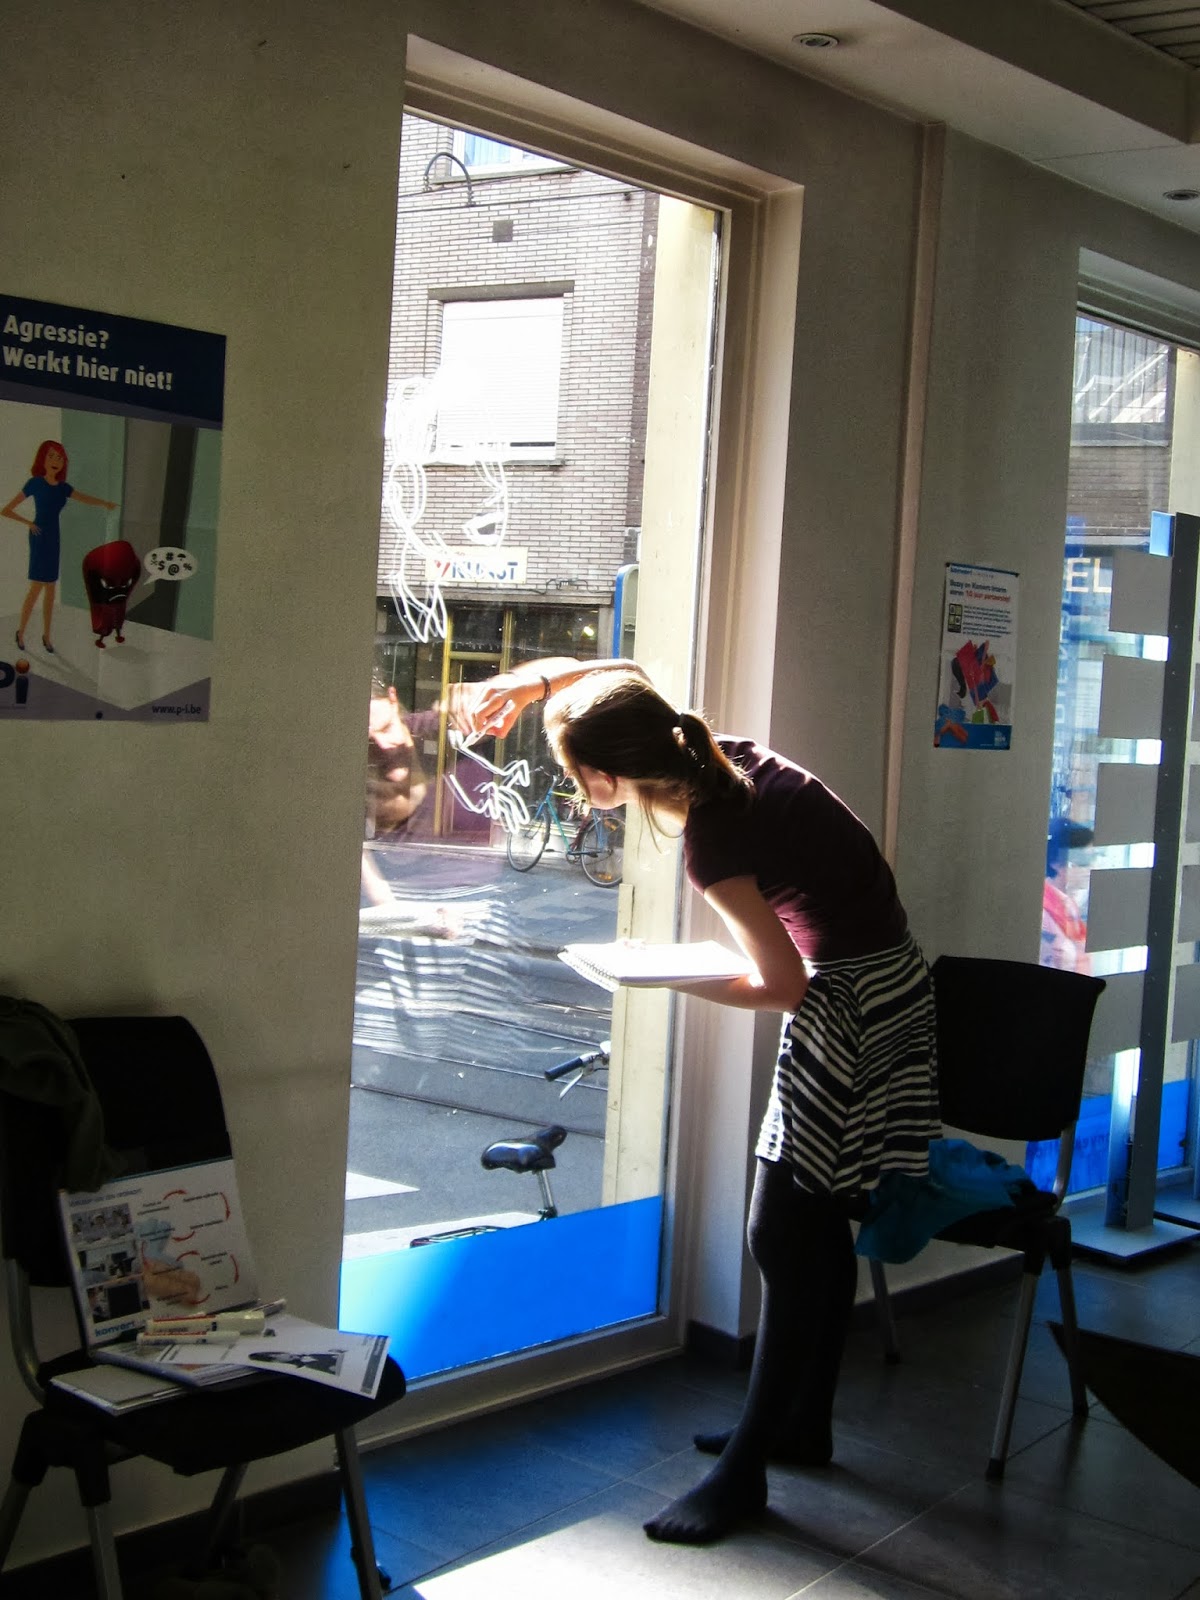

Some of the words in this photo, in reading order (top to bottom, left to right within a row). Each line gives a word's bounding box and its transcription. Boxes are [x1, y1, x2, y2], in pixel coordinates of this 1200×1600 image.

[3, 314, 110, 350] Agressie?
[3, 345, 71, 375] Werkt
[76, 354, 119, 382] hier
[125, 365, 173, 391] niet!
[152, 704, 201, 716] www.p-i.be
